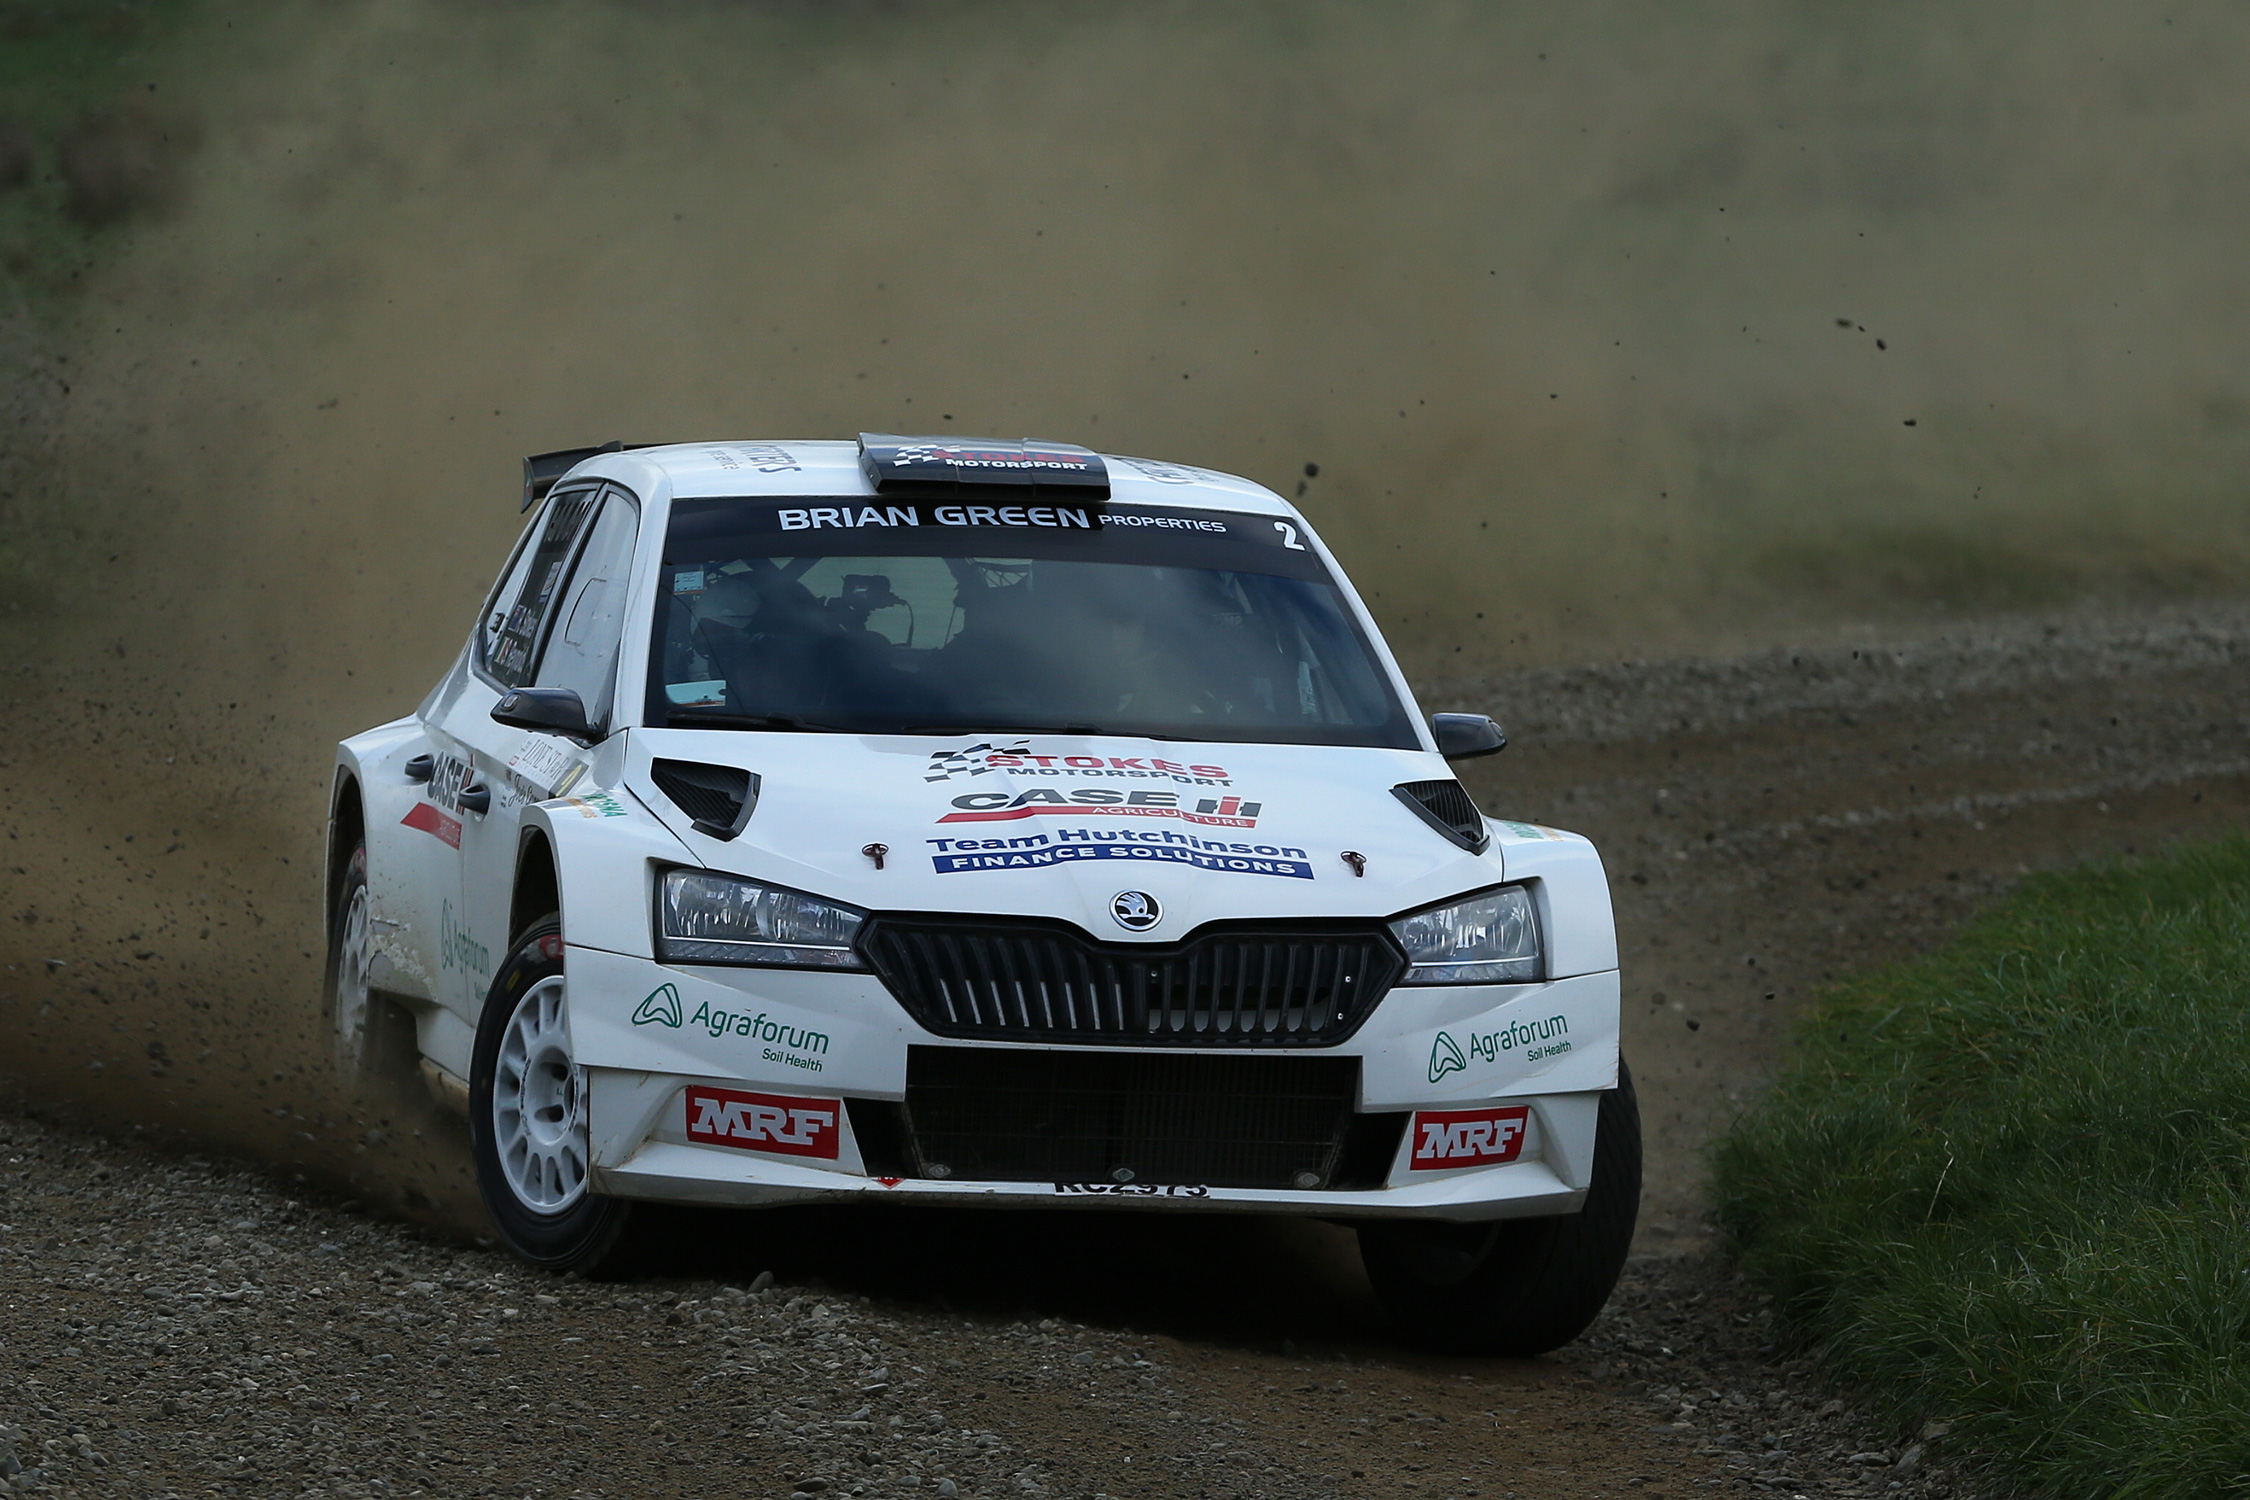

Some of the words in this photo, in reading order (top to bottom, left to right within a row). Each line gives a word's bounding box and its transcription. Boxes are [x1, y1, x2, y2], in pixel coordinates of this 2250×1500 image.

[945, 459, 1088, 470] MOTORSPORT
[778, 506, 919, 531] BRIAN
[934, 506, 1090, 529] GREEN
[1098, 514, 1227, 533] PROPERTIES
[1273, 521, 1306, 551] 2
[986, 754, 1230, 779] STOKES
[1007, 767, 1234, 787] MOTORSPORT
[427, 752, 464, 812] CASE
[951, 788, 1180, 810] CASE
[1092, 805, 1250, 827] AGRICULTURE
[927, 833, 1049, 853] Team
[1060, 829, 1309, 859] Hutchinson
[951, 846, 1096, 870] FINANCE
[1109, 846, 1297, 875] SOLUTIONS
[690, 1000, 829, 1055] Agraforum
[1470, 1014, 1568, 1063] Agraforum
[762, 1047, 783, 1063] Soil
[785, 1052, 823, 1073] Health
[1527, 1049, 1543, 1062] Soil
[1545, 1041, 1572, 1057] Health
[691, 1097, 834, 1147] MRF
[1416, 1118, 1523, 1159] MRF
